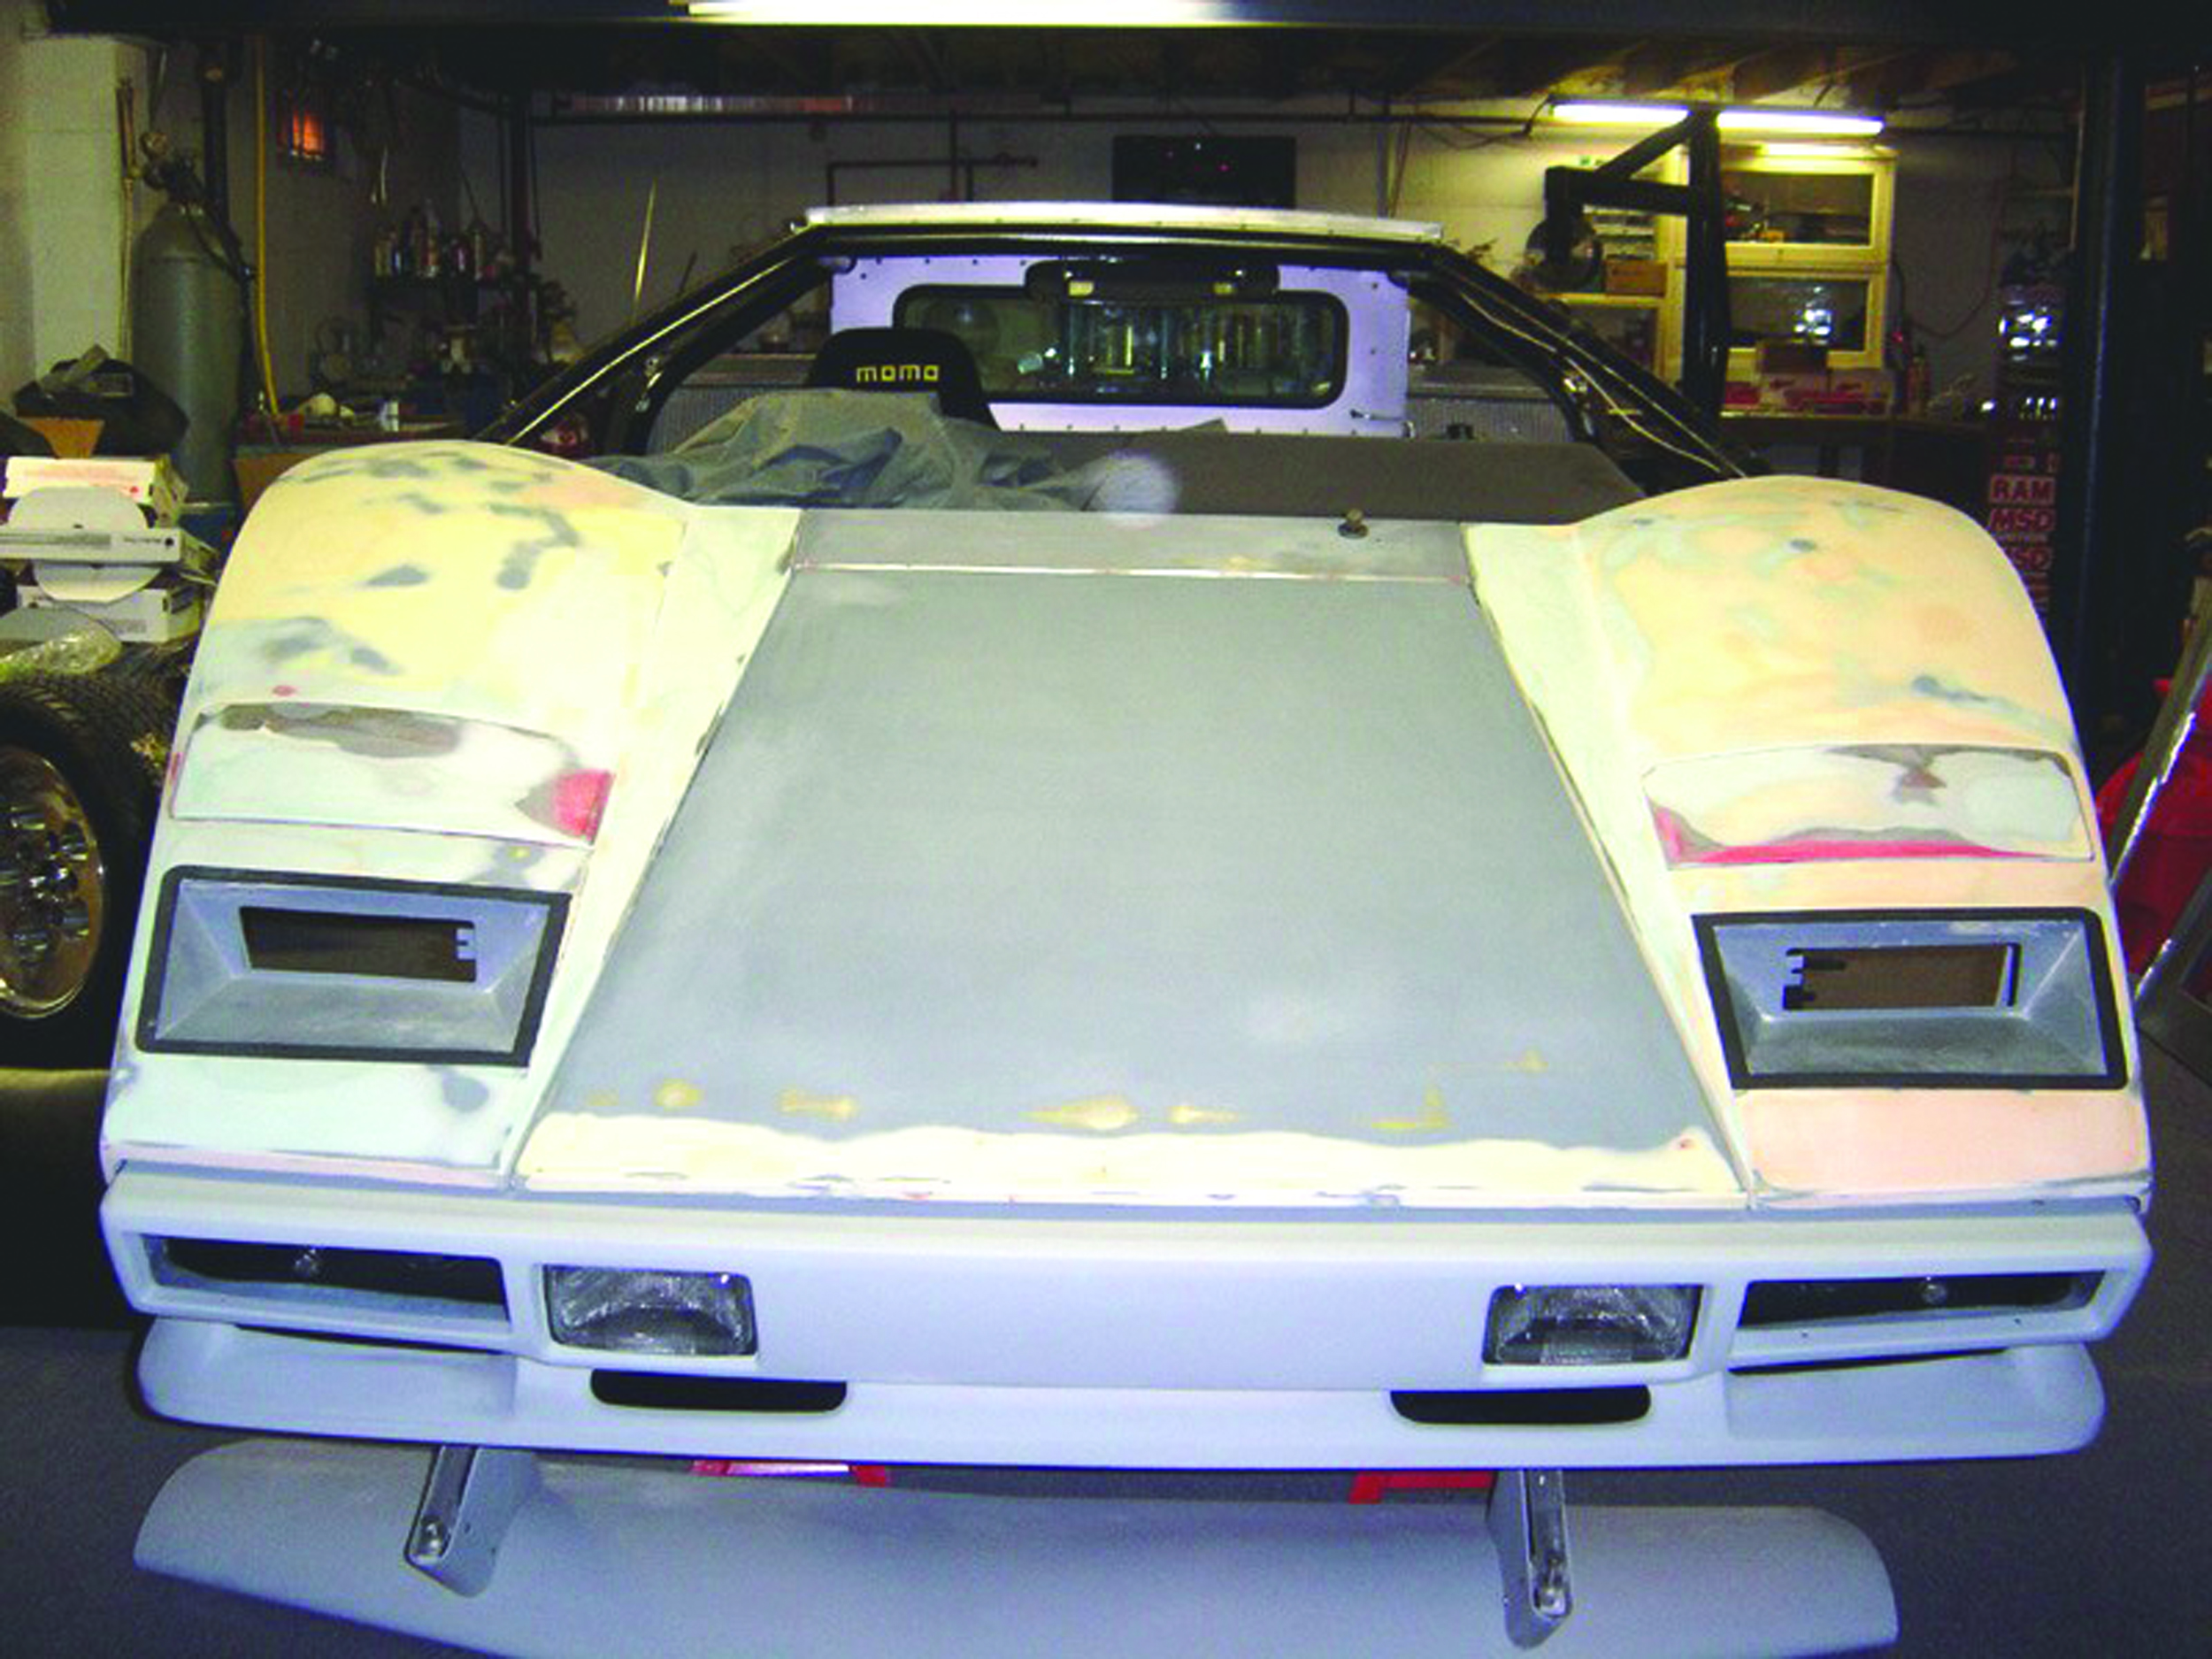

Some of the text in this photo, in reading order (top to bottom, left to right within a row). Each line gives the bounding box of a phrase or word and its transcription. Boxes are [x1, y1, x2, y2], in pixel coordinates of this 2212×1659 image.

[856, 364, 941, 382] momo
[1992, 478, 2053, 500] RAM
[1991, 509, 2054, 531] MSD
